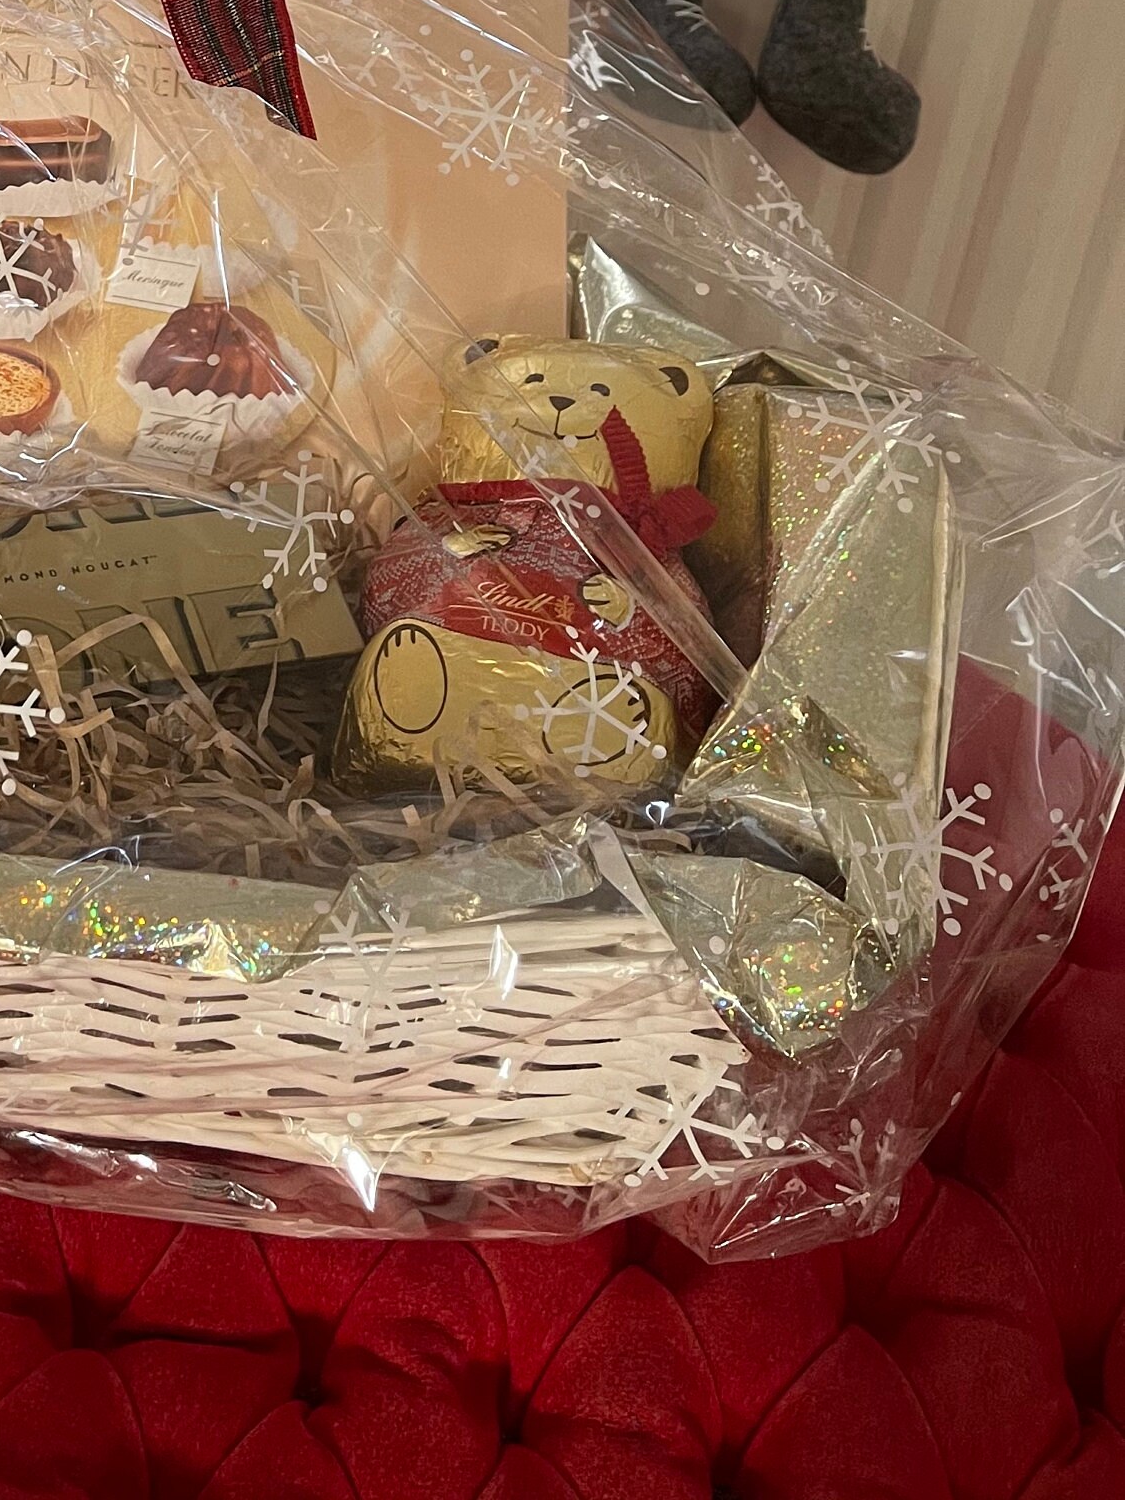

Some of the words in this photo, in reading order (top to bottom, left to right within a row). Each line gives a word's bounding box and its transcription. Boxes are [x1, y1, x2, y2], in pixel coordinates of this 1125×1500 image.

[121, 268, 185, 290] Meringue
[156, 424, 213, 444] ocolat
[143, 434, 201, 459] Fondan
[477, 580, 556, 612] Lindt
